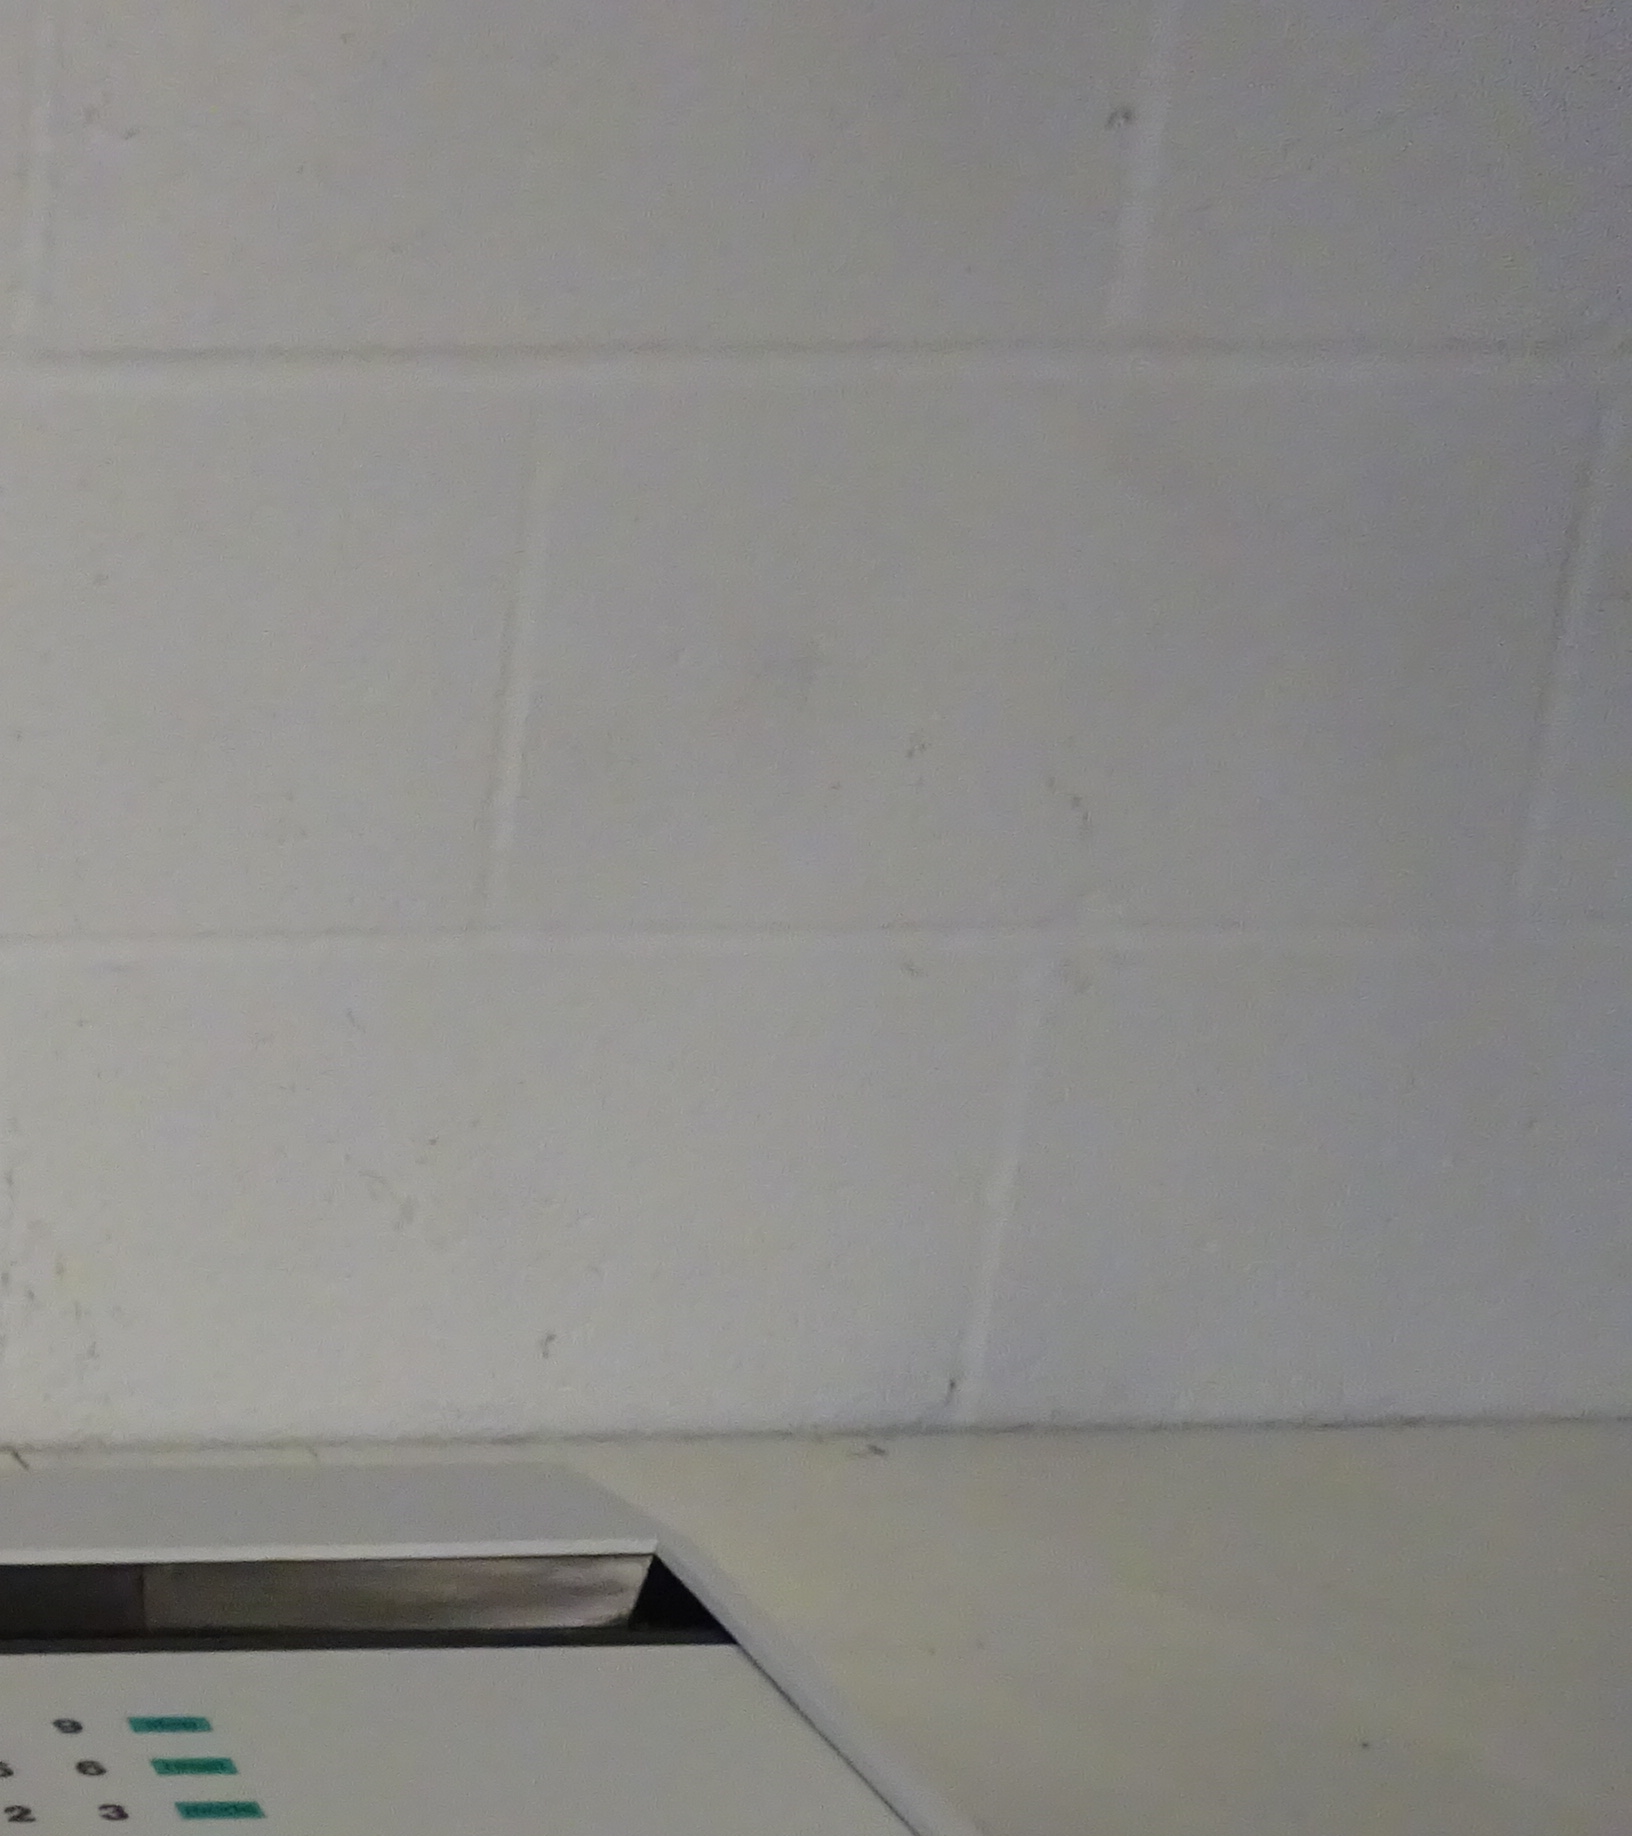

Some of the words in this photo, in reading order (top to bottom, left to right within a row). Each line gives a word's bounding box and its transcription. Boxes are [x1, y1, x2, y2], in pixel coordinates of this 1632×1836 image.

[52, 1717, 83, 1735] 9
[75, 1759, 107, 1777] 6
[4, 1804, 36, 1823] 2
[99, 1803, 129, 1821] 3
